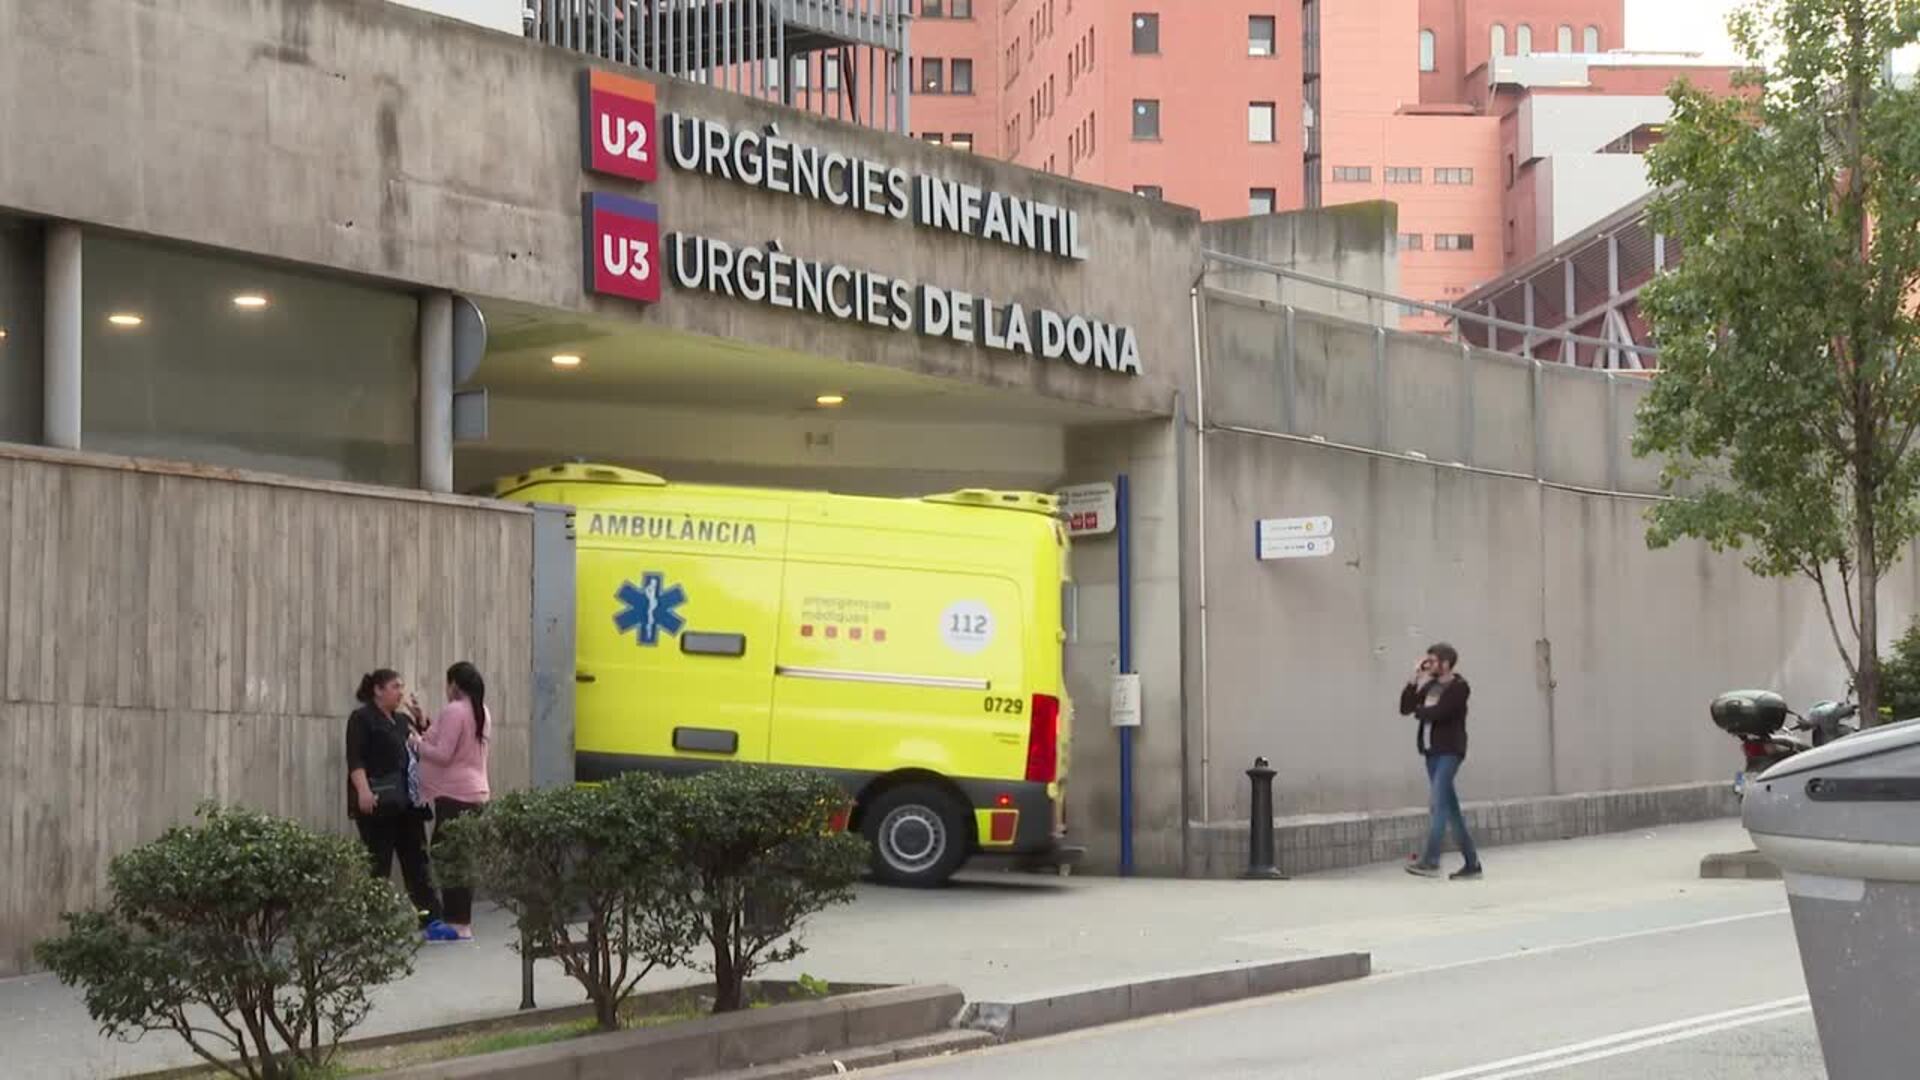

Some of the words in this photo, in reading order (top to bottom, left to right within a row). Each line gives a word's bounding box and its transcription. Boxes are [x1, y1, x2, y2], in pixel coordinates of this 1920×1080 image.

[600, 113, 648, 163] U2
[670, 112, 909, 219] URGÈNCIES
[921, 175, 1089, 261] INFANTIL
[603, 233, 650, 282] U3
[675, 232, 912, 331] URGÈNCIES
[923, 289, 975, 342] DE
[981, 298, 1033, 354] LA
[1040, 310, 1144, 375] DONA
[588, 513, 757, 546] AMBULÀNCIA
[949, 613, 987, 634] 112
[984, 696, 1024, 715] 0729
